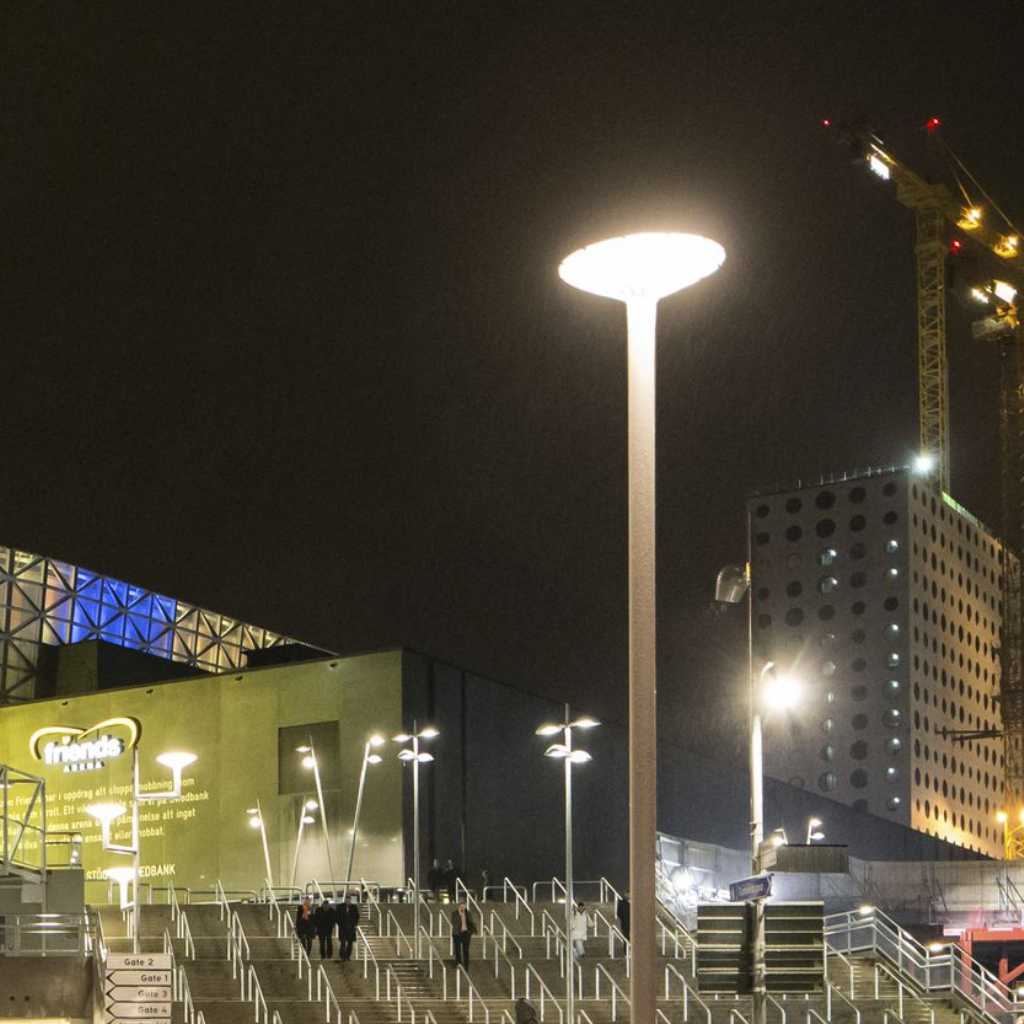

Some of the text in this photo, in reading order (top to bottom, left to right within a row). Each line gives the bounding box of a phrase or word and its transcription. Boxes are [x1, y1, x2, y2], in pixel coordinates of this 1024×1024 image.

[124, 958, 154, 966] Gate 2
[141, 974, 168, 982] Gate 1
[138, 1006, 158, 1014] Gate
